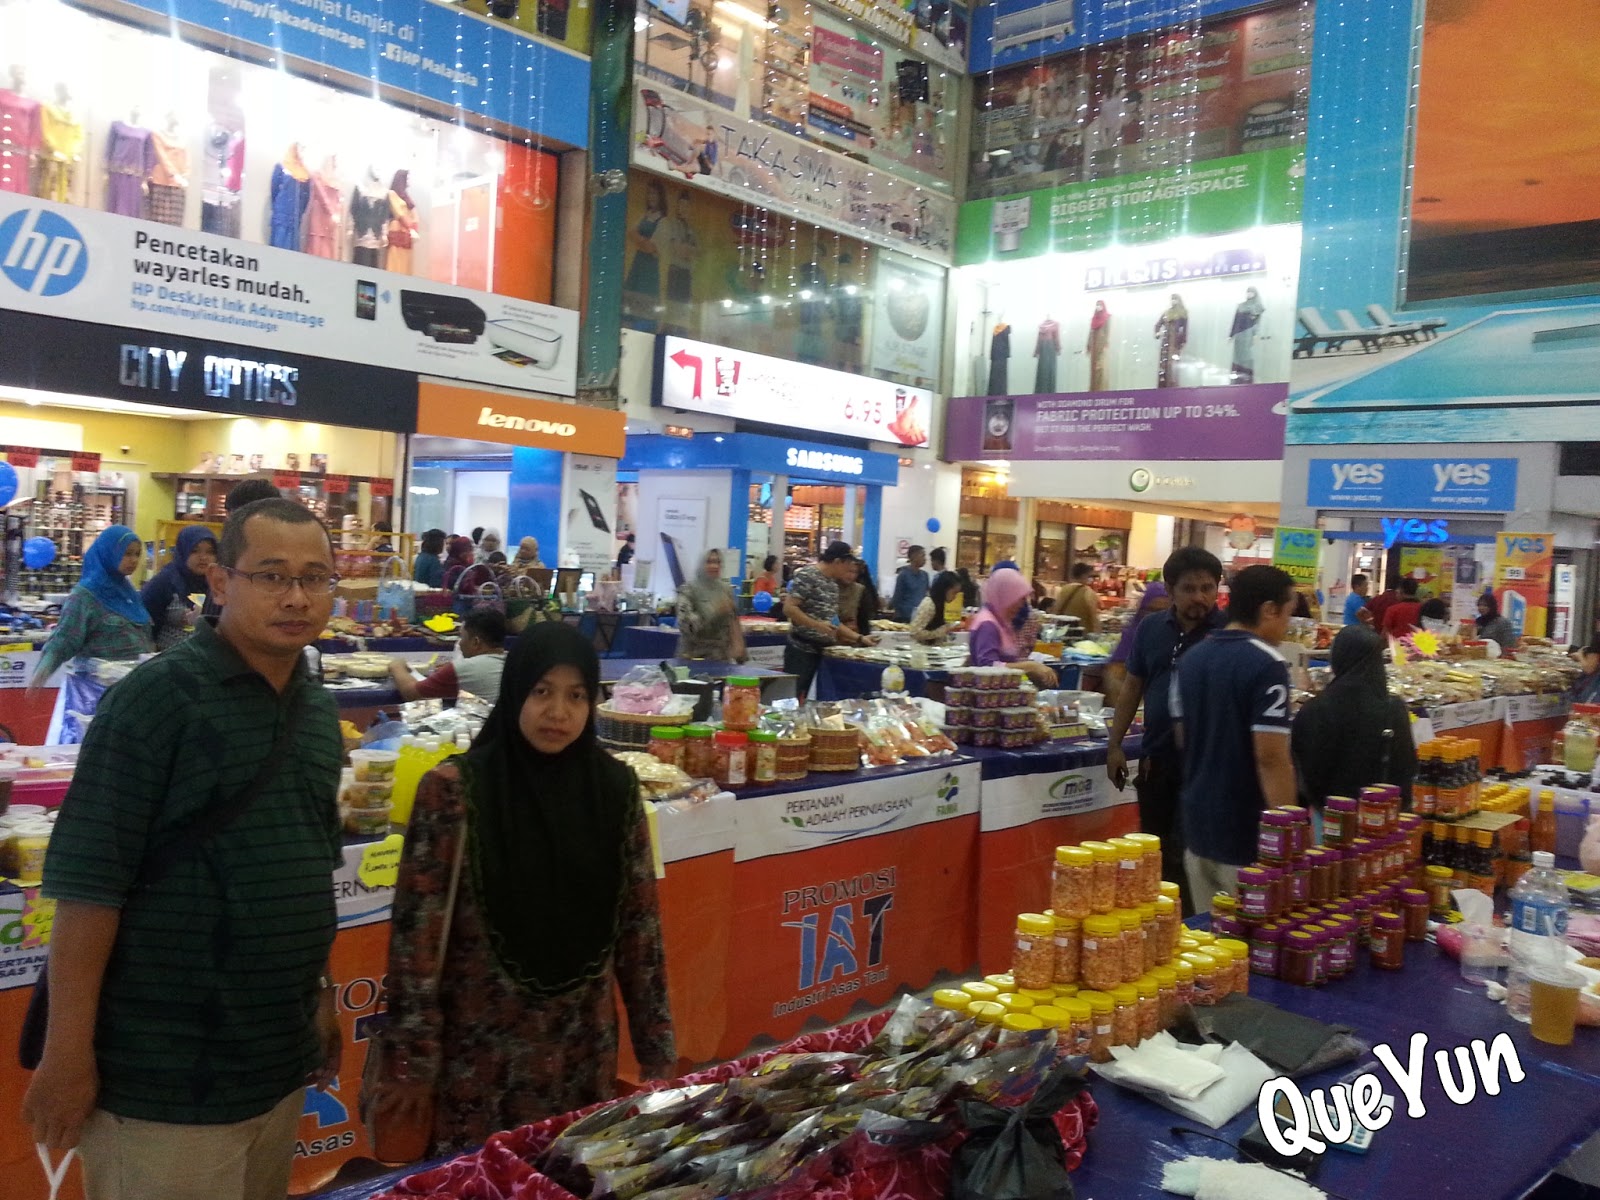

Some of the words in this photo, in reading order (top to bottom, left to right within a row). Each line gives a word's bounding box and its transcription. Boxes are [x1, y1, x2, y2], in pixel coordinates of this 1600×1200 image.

[399, 23, 414, 42] di
[1050, 197, 1107, 217] BIGGER
[1111, 182, 1185, 207] STORAGE
[1187, 174, 1249, 196] SPACE.
[2, 208, 83, 297] hp
[134, 231, 259, 271] Pencetakan
[134, 258, 230, 289] wayarles
[236, 277, 310, 304] mudah.
[131, 281, 154, 296] HP
[158, 285, 218, 309] DeskJet
[222, 297, 245, 313] Ink
[250, 302, 325, 329] Advantage
[118, 344, 187, 392] CITY
[202, 355, 299, 407] OPTICS
[477, 406, 577, 438] lenovo
[844, 397, 883, 425] 6.95
[1036, 409, 1079, 422] FABRIC
[1081, 407, 1160, 421] PROTECTION
[1163, 406, 1182, 419] UP
[1185, 405, 1202, 418] TO
[1093, 423, 1127, 432] PERFECT
[786, 447, 864, 475] SAMSUNG
[1331, 463, 1385, 490] yes
[1433, 463, 1491, 492] yes
[1280, 531, 1316, 550] yes
[1380, 517, 1449, 549] yes
[1504, 536, 1546, 557] yes
[1264, 684, 1288, 718] 2
[786, 793, 844, 814] PERTANIAN
[806, 810, 847, 826] ADALAH
[849, 796, 914, 819] PERNIAGAAN
[781, 866, 897, 914] PROMOSI
[780, 893, 895, 992] IAT
[773, 985, 827, 1019] Industri
[828, 977, 861, 999] Asas
[864, 966, 890, 987] Tani
[294, 1131, 355, 1158] Asas
